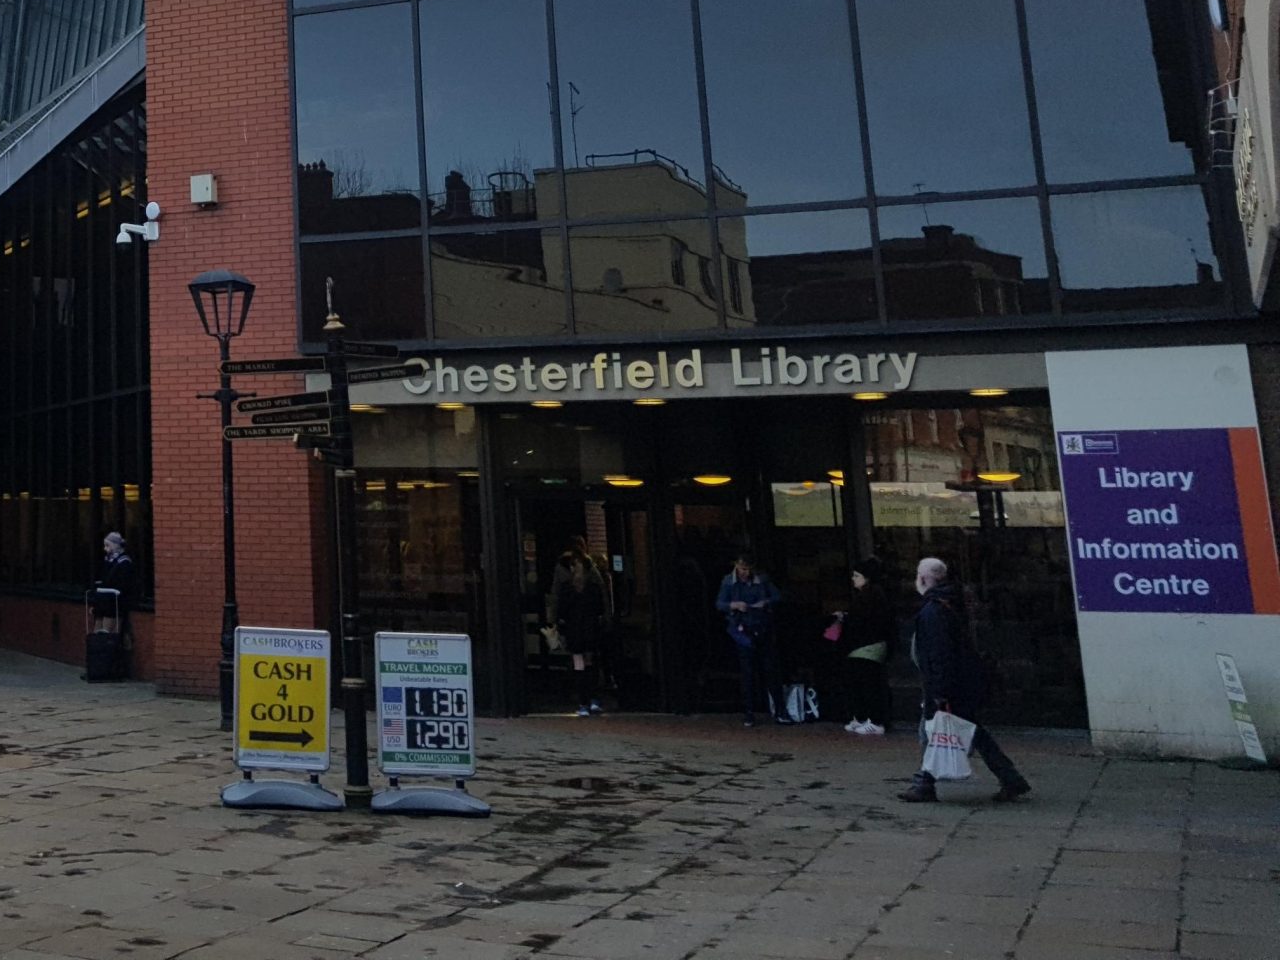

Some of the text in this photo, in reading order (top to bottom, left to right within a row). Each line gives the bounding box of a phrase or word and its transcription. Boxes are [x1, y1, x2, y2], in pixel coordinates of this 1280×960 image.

[402, 346, 918, 394] Chesterfield Library
[1098, 467, 1194, 491] Library
[1127, 503, 1178, 525] and
[1077, 538, 1239, 560] Information
[1113, 571, 1209, 596] Centre
[253, 660, 312, 681] CASH
[384, 662, 464, 674] TRAVEL MONEY?
[276, 684, 289, 701] 4
[414, 689, 467, 717] 1.130
[251, 703, 314, 723] GOLD
[384, 703, 402, 711] EURO
[386, 735, 401, 744] USD
[416, 721, 469, 749] 1.290
[394, 753, 460, 763] 0% COMMISSION
